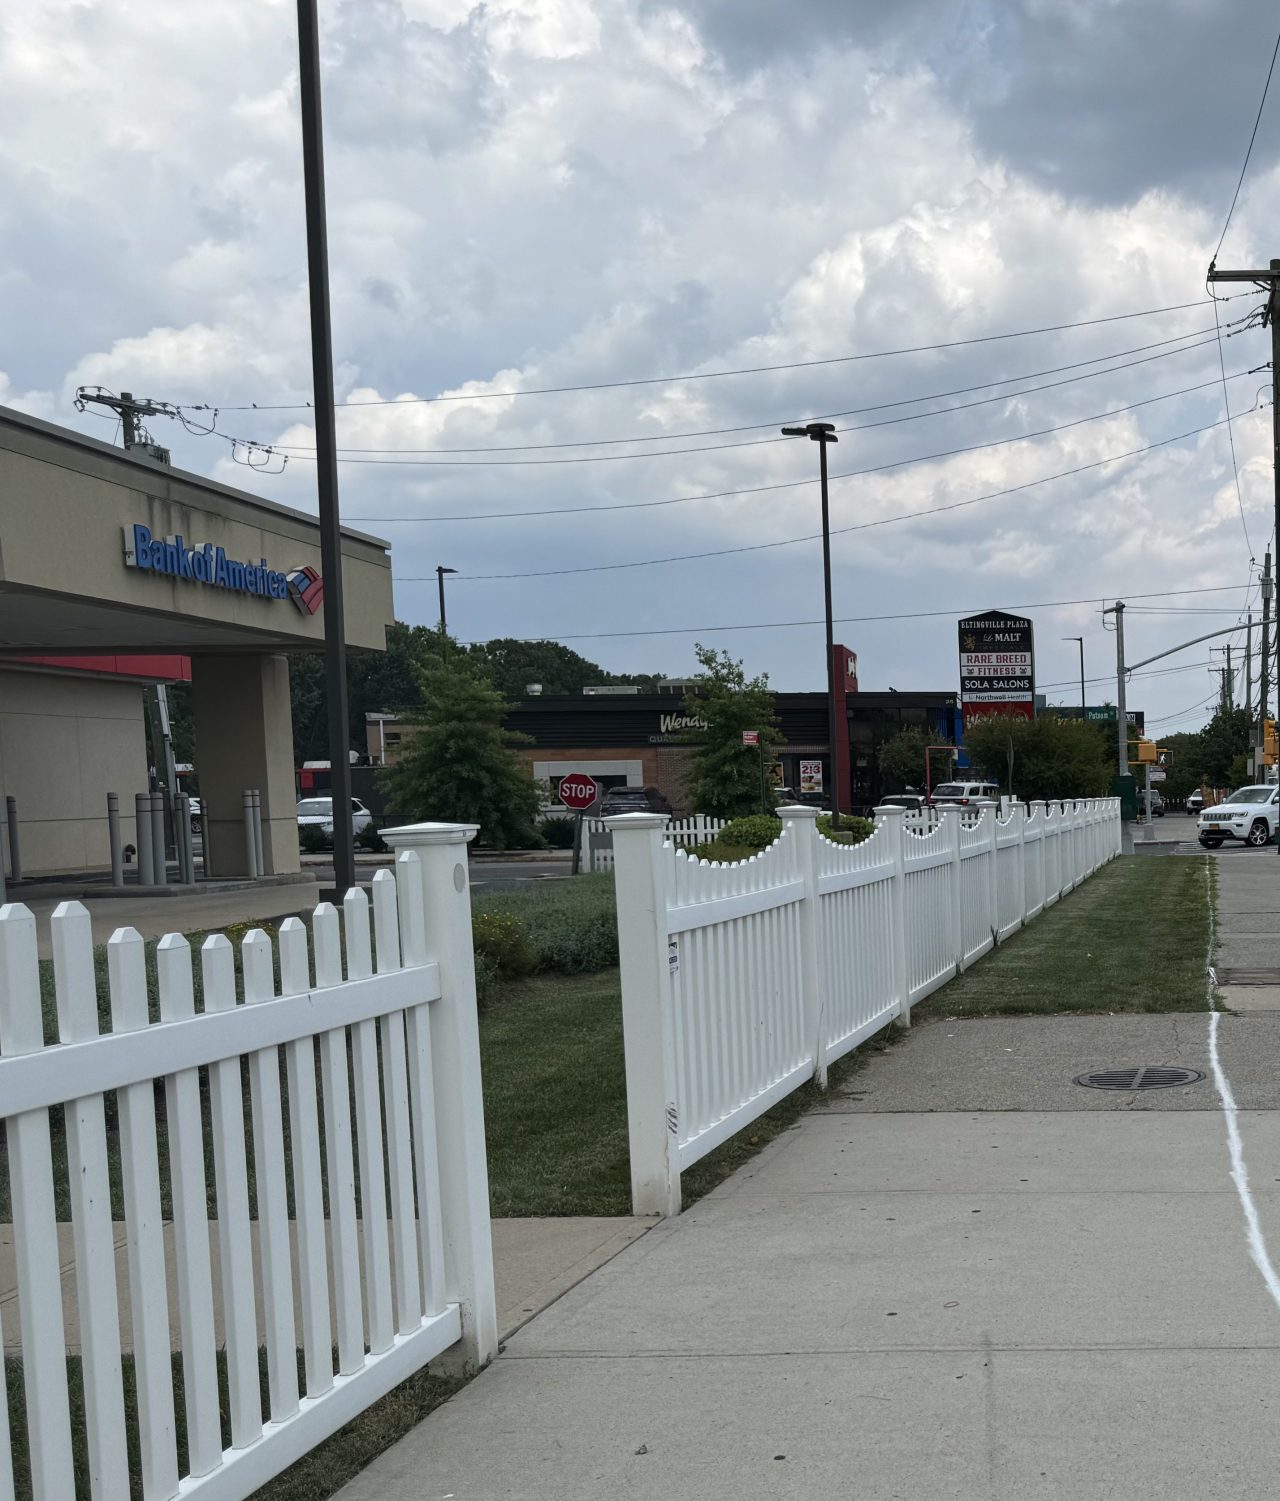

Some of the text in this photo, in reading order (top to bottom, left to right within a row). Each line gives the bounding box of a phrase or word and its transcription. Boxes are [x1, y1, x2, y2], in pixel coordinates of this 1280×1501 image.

[134, 524, 289, 601] Bank of America
[961, 620, 1029, 629] ELTINGVILLE PLAZA
[994, 633, 1021, 641] MALT
[966, 654, 1026, 664] RARE BREED
[978, 667, 1016, 675] FITNESS
[965, 680, 1029, 688] SOLA SALONS
[561, 783, 594, 798] STOP
